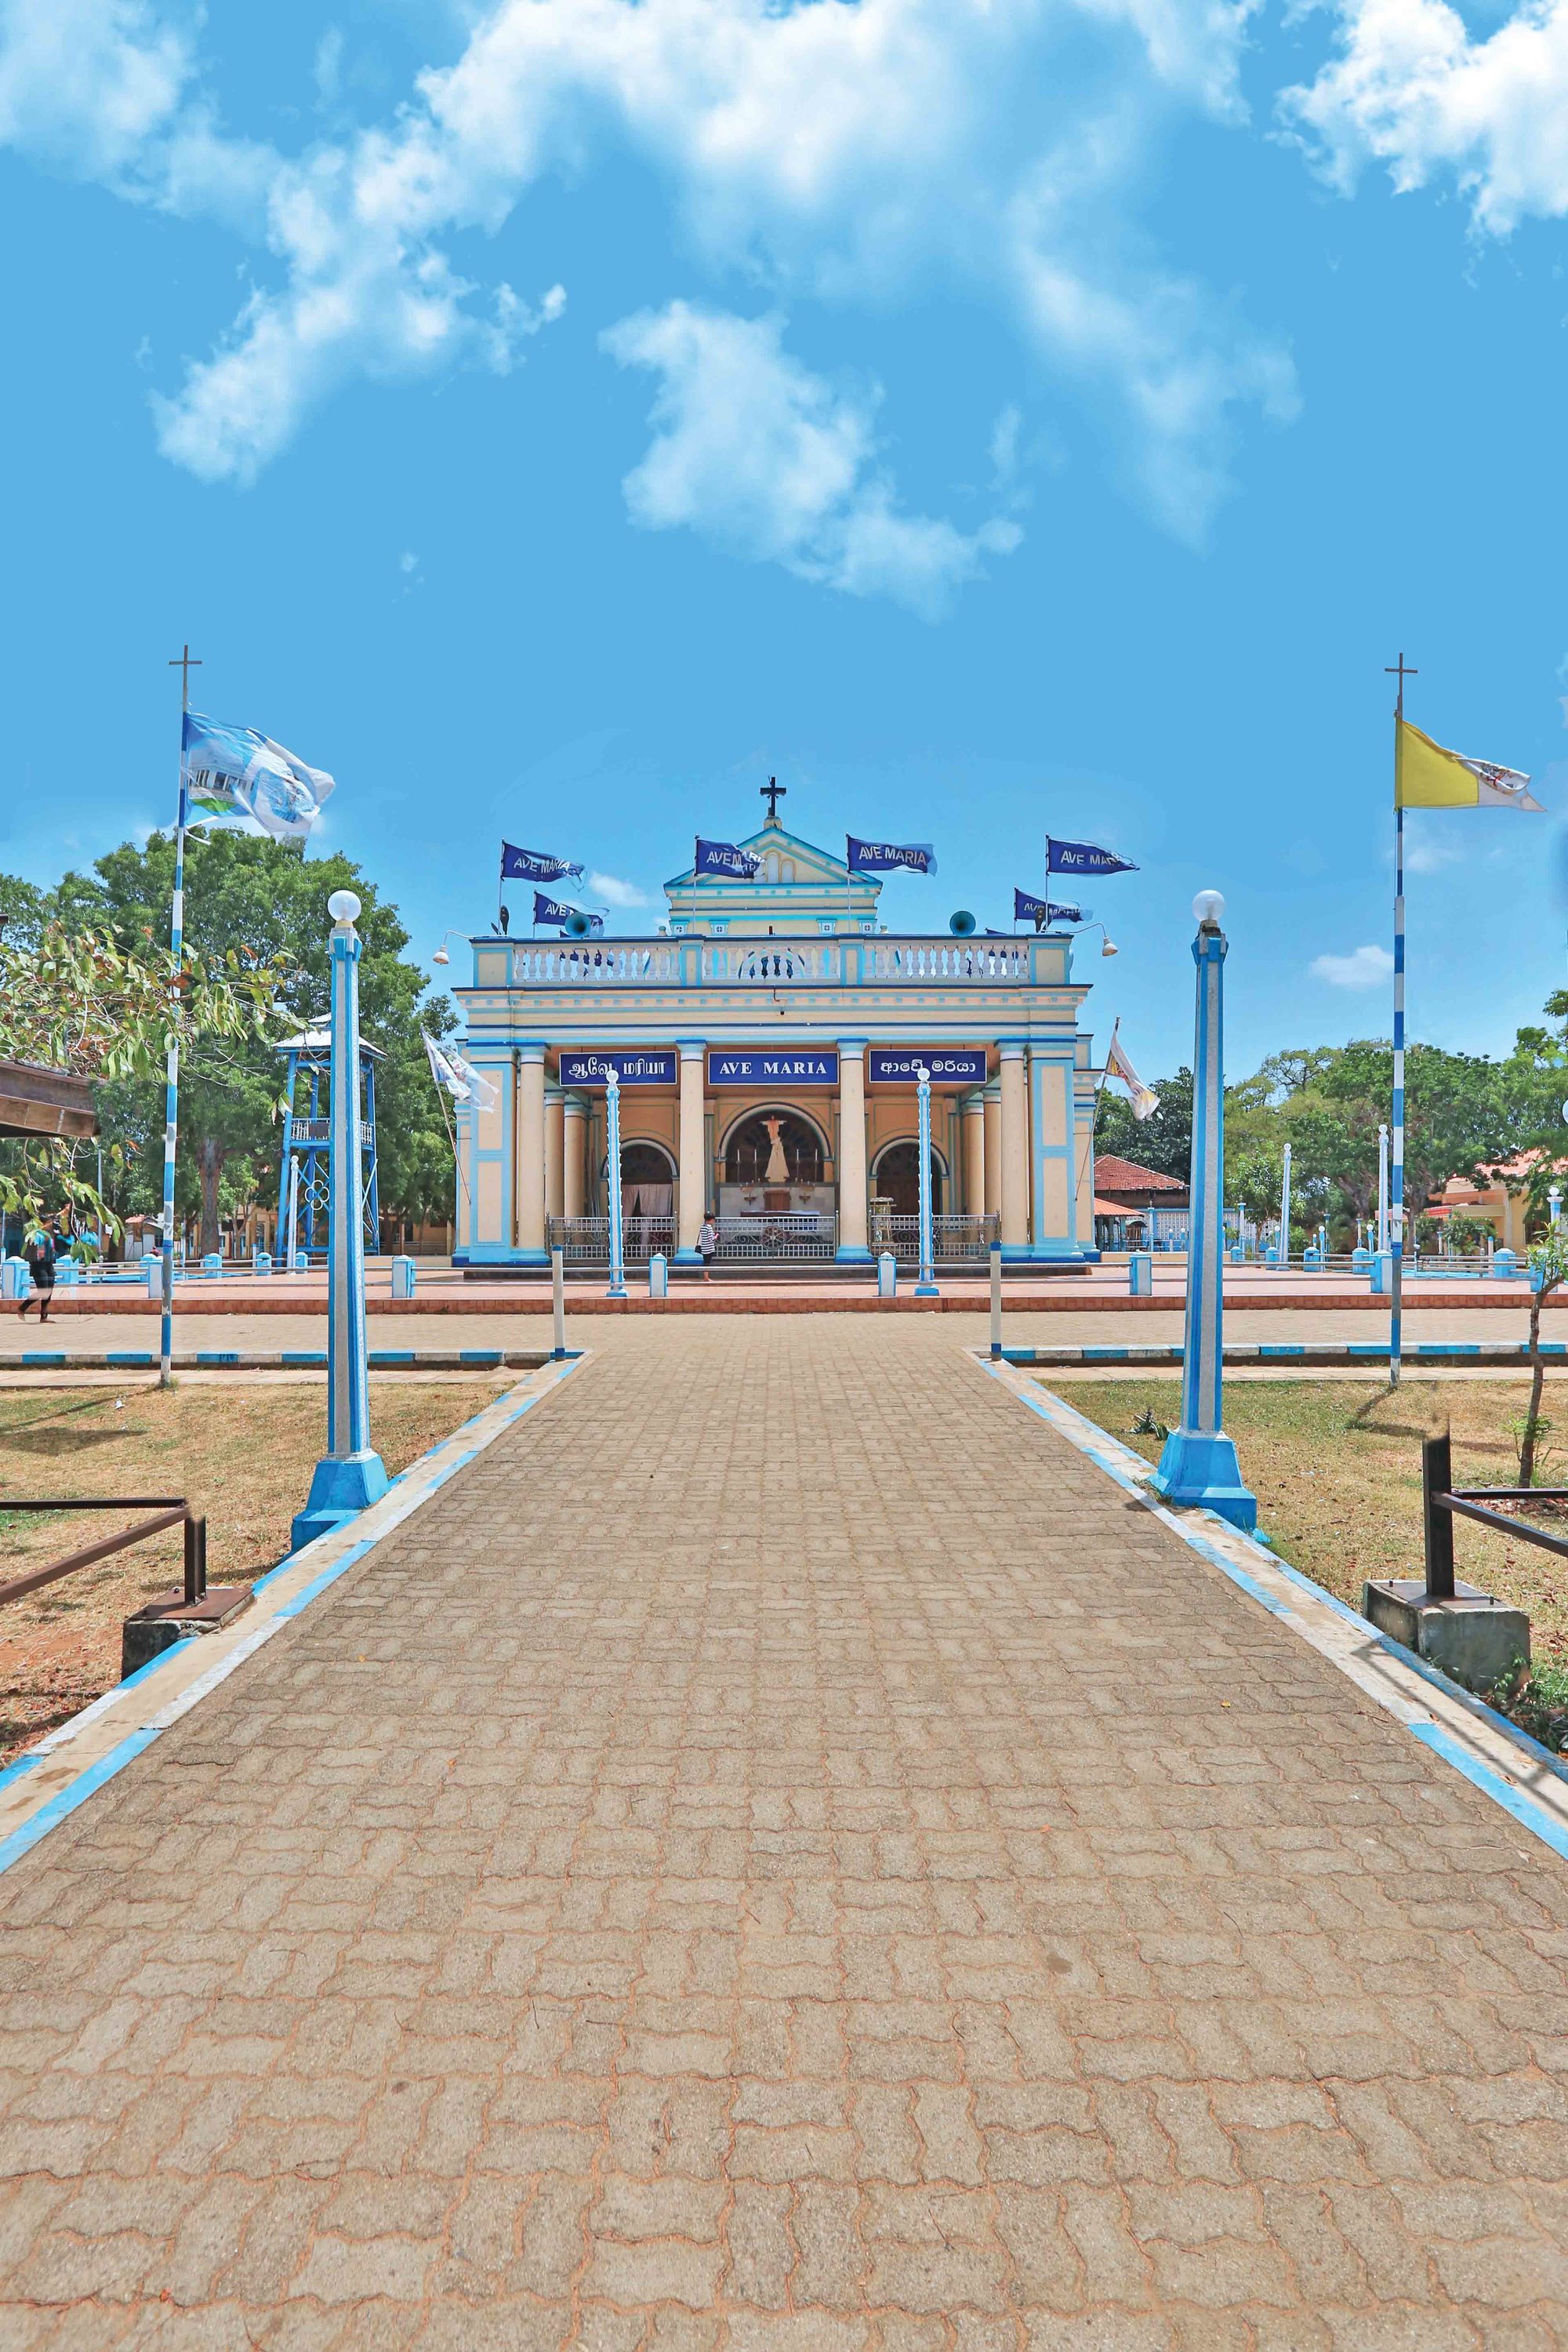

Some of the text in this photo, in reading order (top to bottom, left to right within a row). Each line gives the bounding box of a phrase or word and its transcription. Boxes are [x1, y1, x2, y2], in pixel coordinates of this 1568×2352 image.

[706, 851, 731, 866] AVE
[858, 846, 927, 865] AVE MARIA
[1060, 850, 1084, 866] AVE
[514, 858, 571, 873] AVE MARIA
[544, 903, 568, 916] AVE
[623, 1058, 666, 1076] மரியா
[720, 1062, 827, 1074] AVE MARIA
